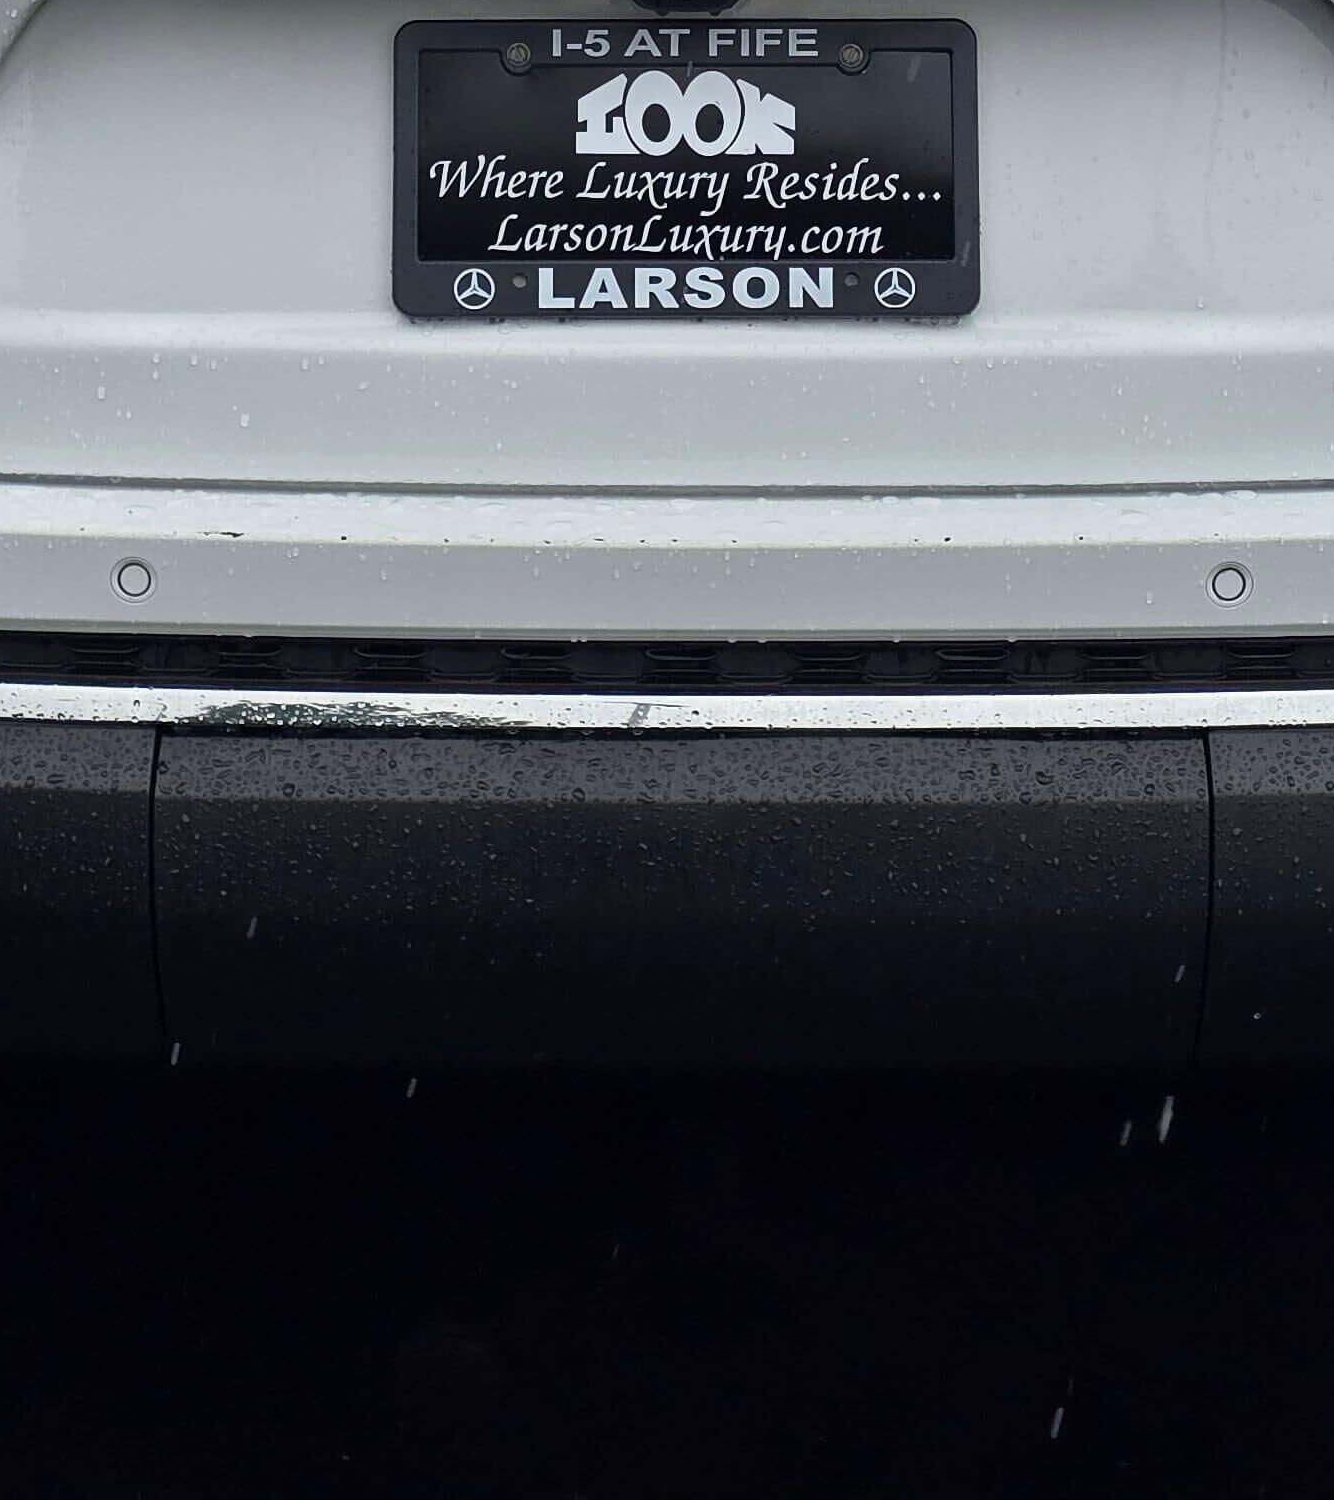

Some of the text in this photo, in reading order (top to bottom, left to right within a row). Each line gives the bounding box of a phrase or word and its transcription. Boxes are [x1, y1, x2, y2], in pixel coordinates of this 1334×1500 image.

[551, 28, 819, 58] I-5 AT FIFE
[428, 154, 942, 217] Where Luxury Resides...
[487, 213, 885, 261] LarsonLuxury.com
[537, 266, 835, 309] LARSON
